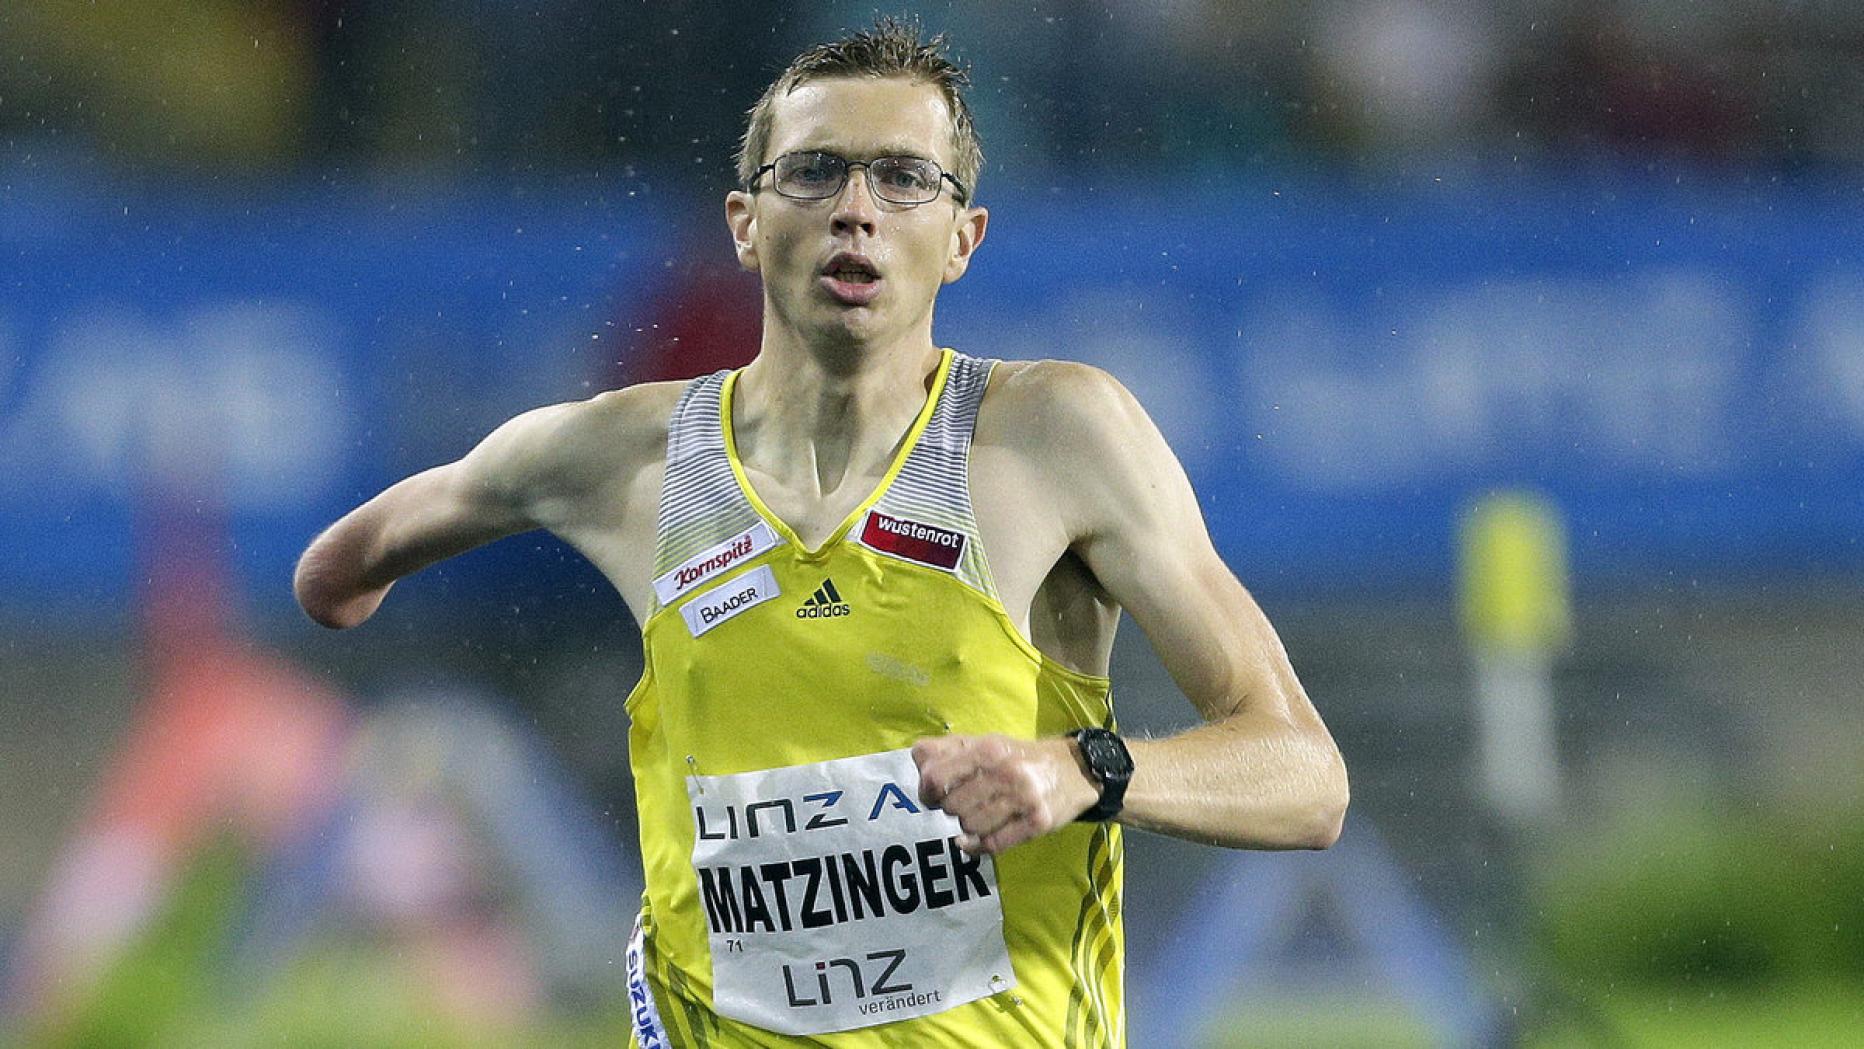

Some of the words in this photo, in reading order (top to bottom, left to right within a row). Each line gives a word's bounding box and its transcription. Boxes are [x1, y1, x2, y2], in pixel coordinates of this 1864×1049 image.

[673, 533, 753, 590] Kornspitz
[796, 603, 850, 618] adidas
[867, 782, 928, 821] A
[698, 837, 991, 933] MATZINGER
[726, 939, 744, 953] 71
[859, 989, 941, 1015] verändert
